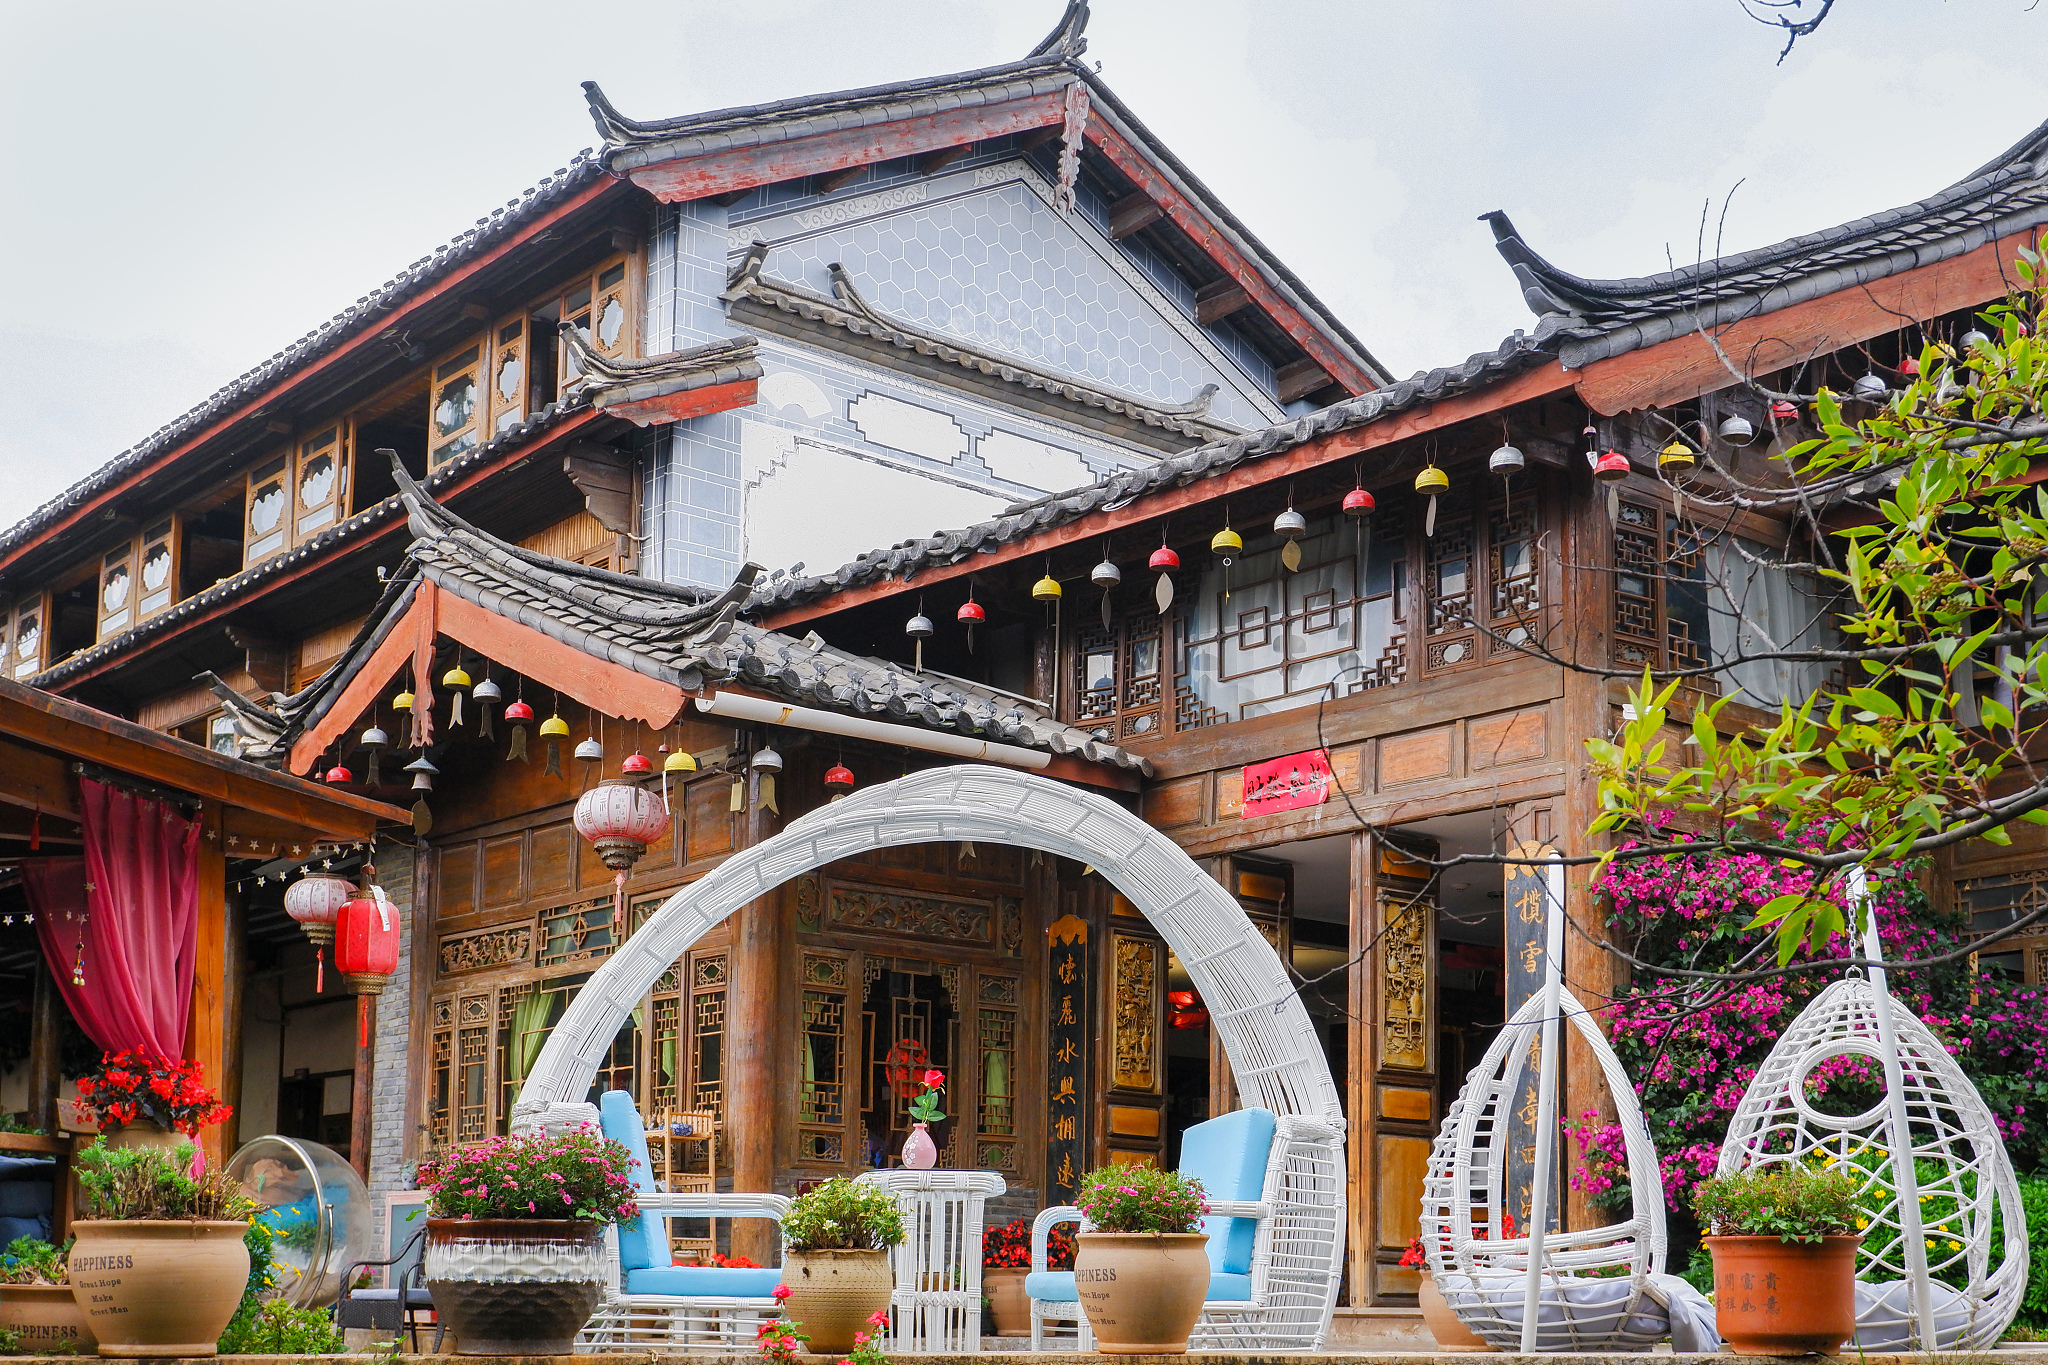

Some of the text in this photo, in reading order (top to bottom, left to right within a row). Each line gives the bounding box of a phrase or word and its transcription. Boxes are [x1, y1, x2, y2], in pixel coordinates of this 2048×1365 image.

[73, 1254, 134, 1272] HAPPINESS
[1074, 1268, 1117, 1282] APPINESS
[79, 1278, 122, 1288] Great Hope
[91, 1294, 113, 1303] Make
[1091, 1291, 1111, 1301] Hope
[90, 1306, 129, 1316] Great Men
[1100, 1317, 1117, 1325] Men
[9, 1323, 79, 1340] HAPPINESS
